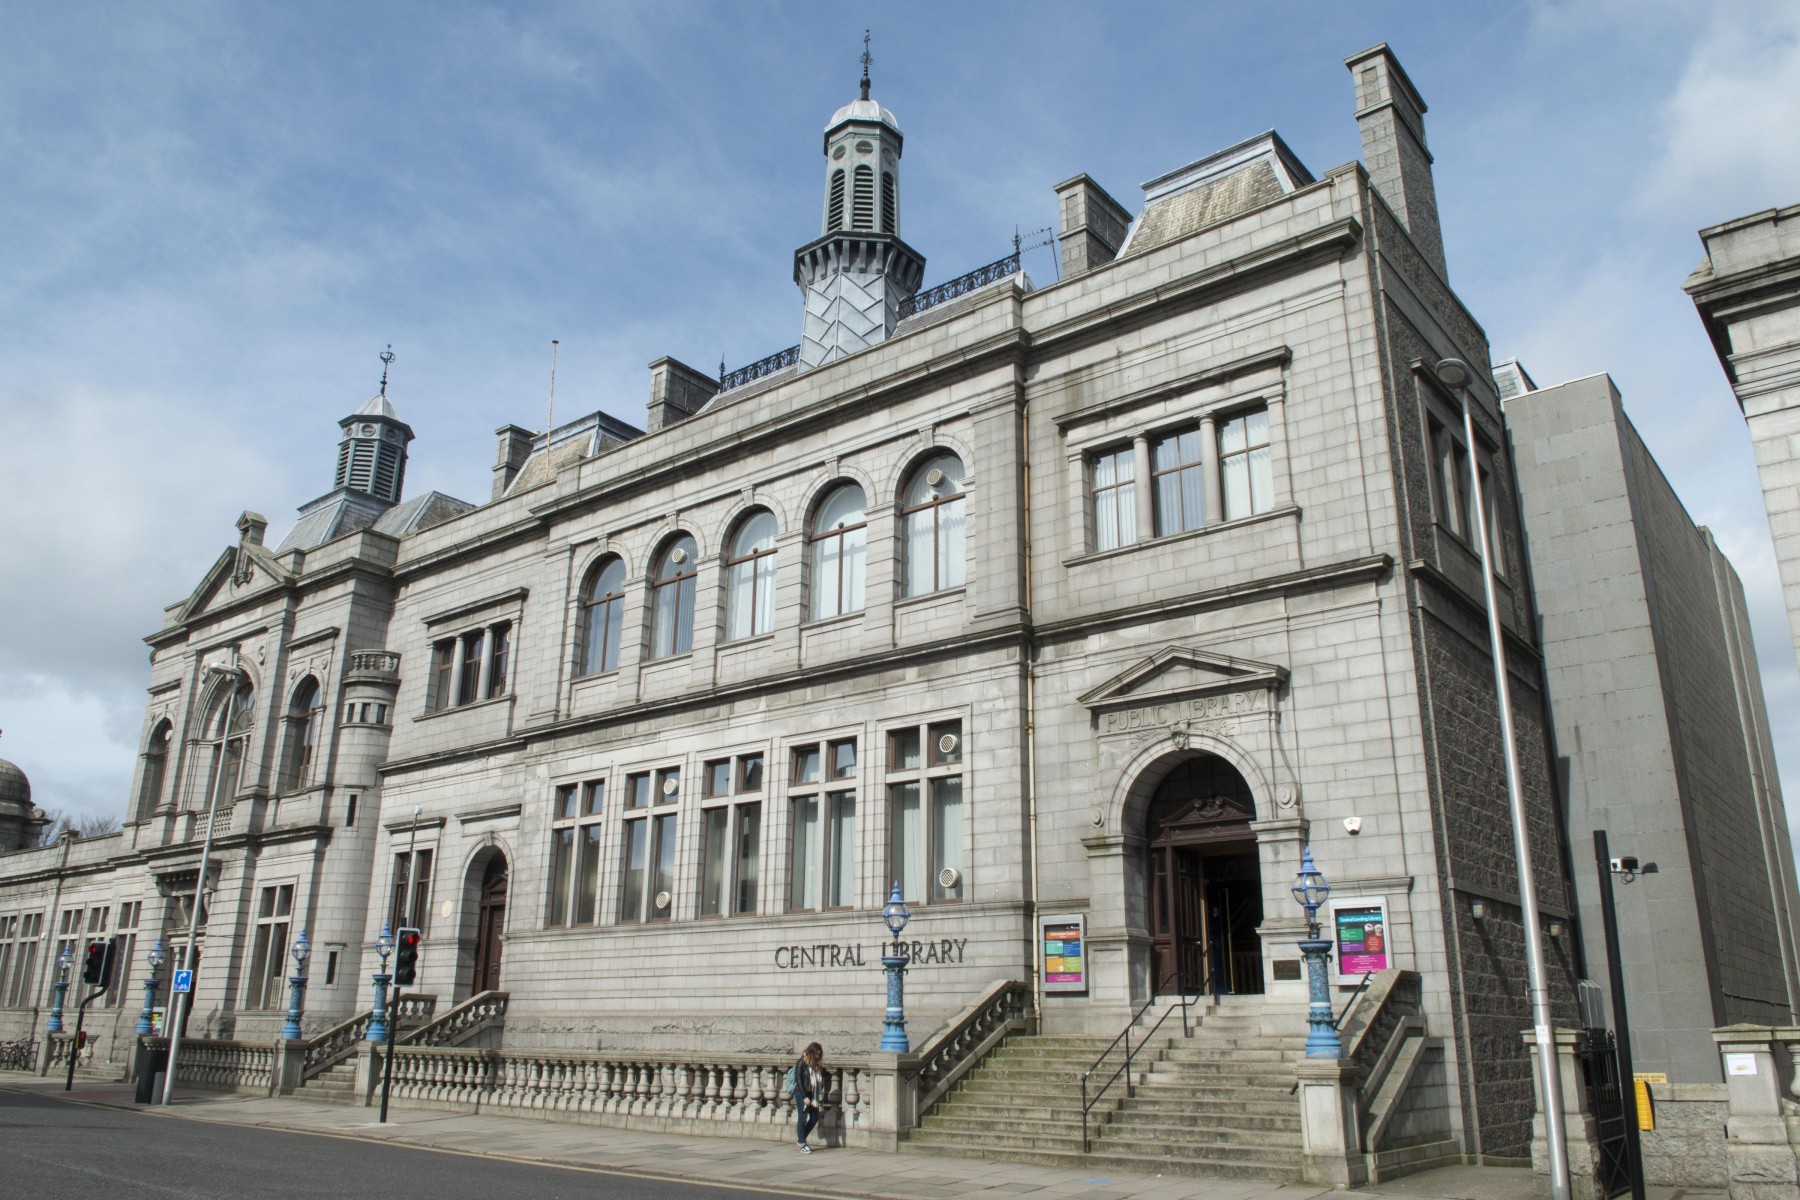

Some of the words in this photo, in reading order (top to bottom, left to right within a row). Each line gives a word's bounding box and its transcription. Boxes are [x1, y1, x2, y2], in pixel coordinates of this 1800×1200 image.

[1107, 705, 1167, 732] PUBLIC
[774, 943, 866, 968] CENTRAL
[881, 938, 968, 965] LBRARY
